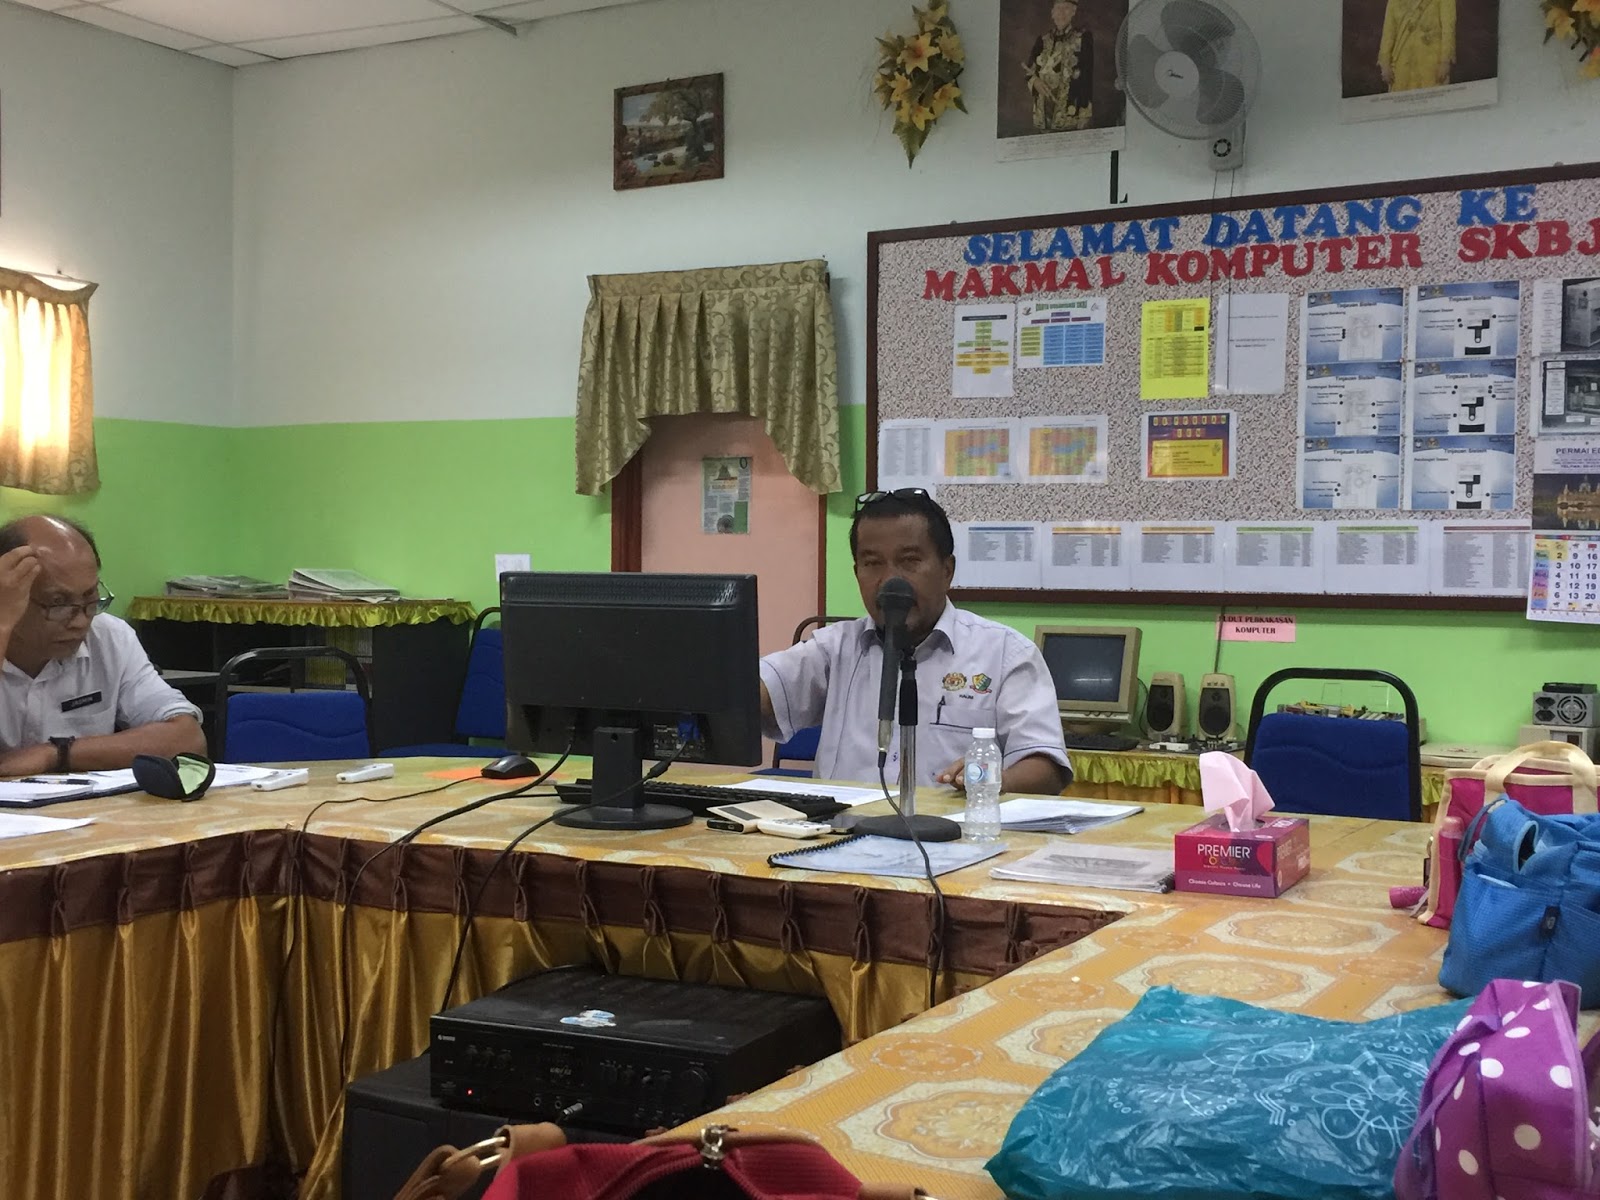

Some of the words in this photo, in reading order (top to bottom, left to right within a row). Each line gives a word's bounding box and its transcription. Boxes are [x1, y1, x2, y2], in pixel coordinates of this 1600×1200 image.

[963, 216, 1180, 266] SELAMAT
[1201, 195, 1423, 249] DATANG
[1457, 185, 1539, 227] KE
[922, 256, 1126, 301] MAKMAL
[1144, 232, 1424, 287] KOMPUTER
[1585, 592, 1596, 600] 20
[1197, 844, 1250, 859] PREMIER
